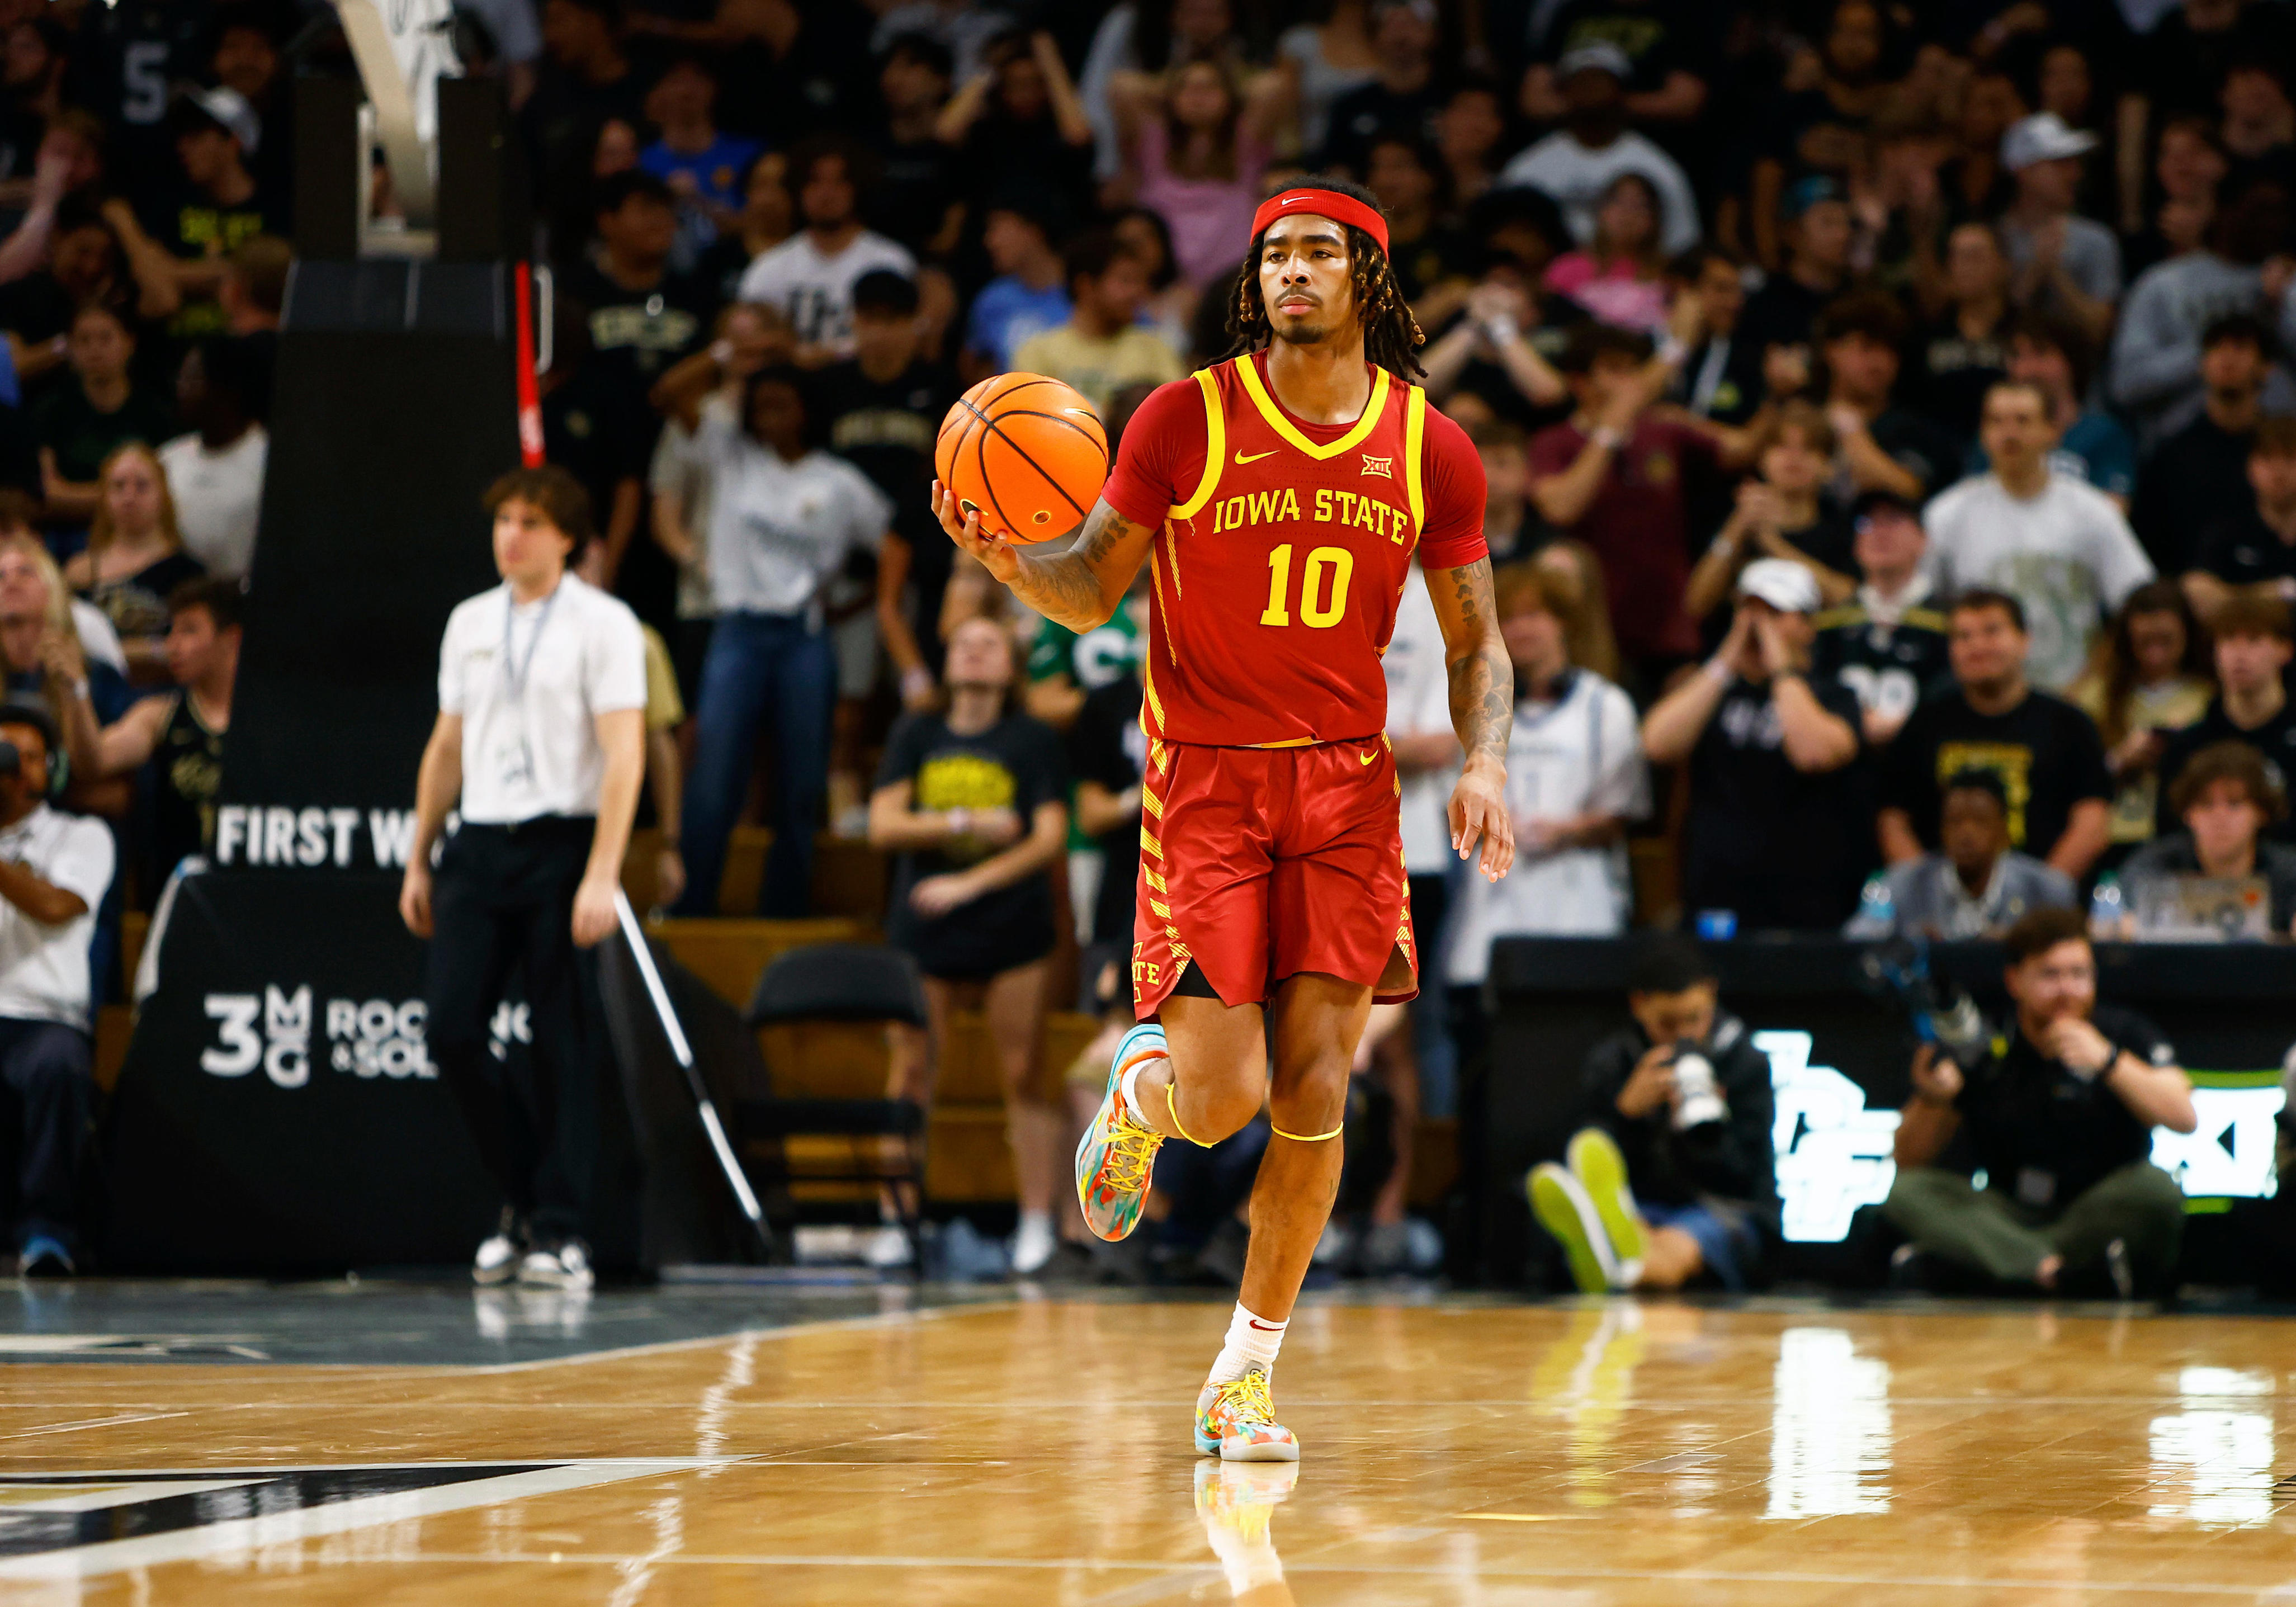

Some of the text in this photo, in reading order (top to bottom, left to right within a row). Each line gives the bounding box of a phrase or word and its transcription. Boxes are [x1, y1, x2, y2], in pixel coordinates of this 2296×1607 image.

[122, 39, 169, 124] 5
[1213, 488, 1408, 546] IOWA STATE
[1259, 543, 1354, 628] 10
[216, 804, 360, 869] FIRST
